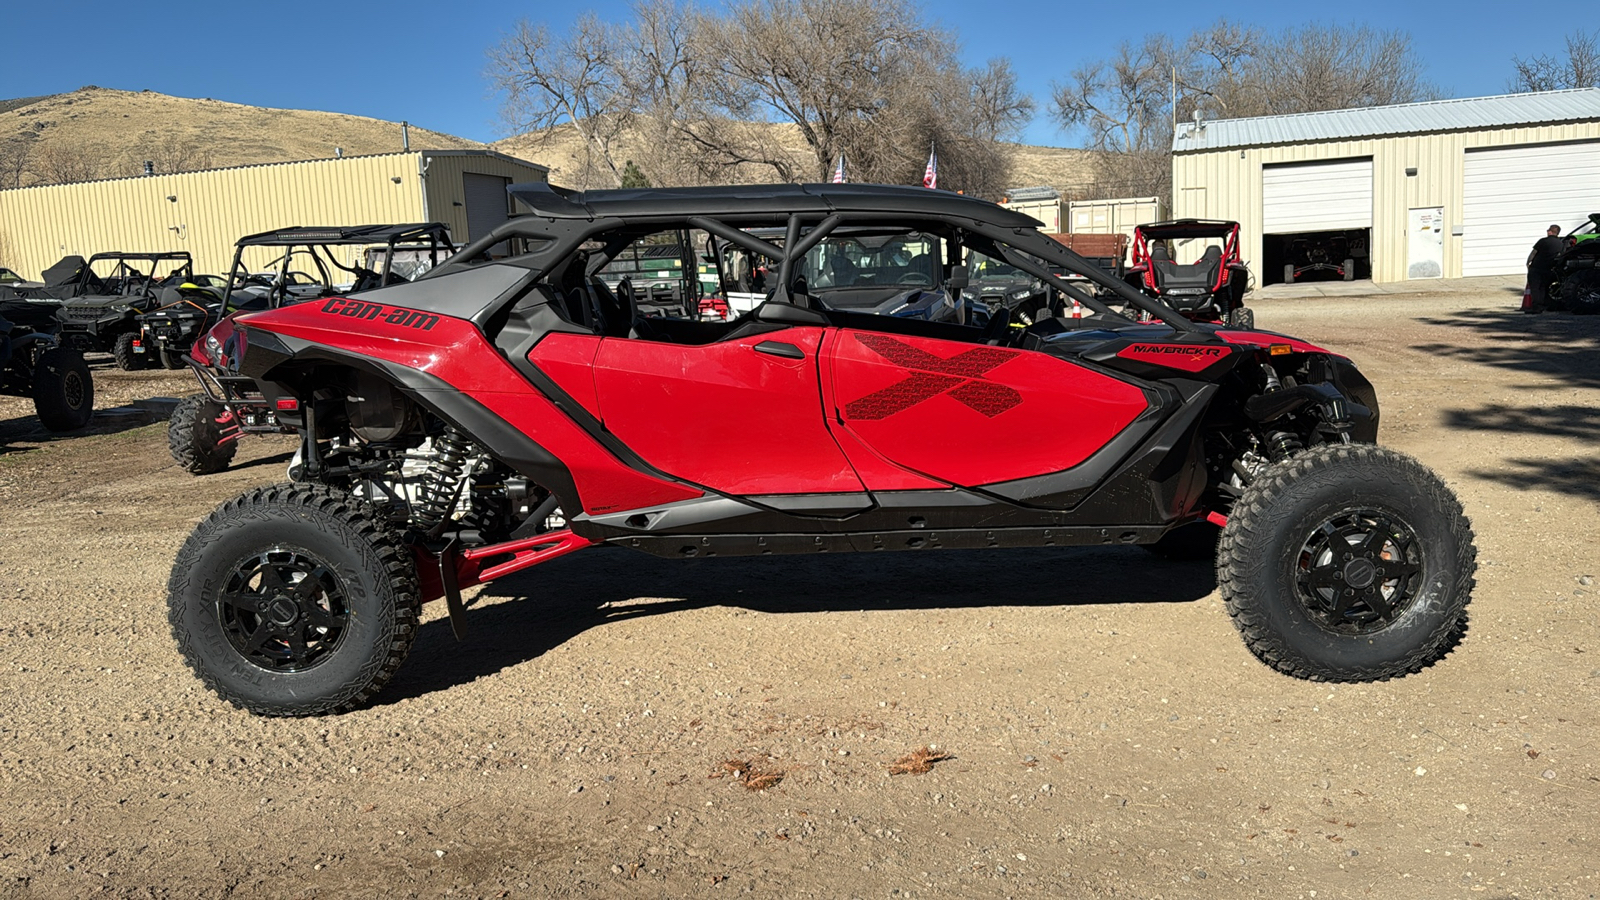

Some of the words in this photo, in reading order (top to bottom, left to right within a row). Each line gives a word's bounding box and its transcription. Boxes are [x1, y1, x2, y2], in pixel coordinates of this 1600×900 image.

[321, 298, 440, 331] can-am
[1134, 346, 1203, 355] MAVERICK
[1206, 348, 1220, 357] R
